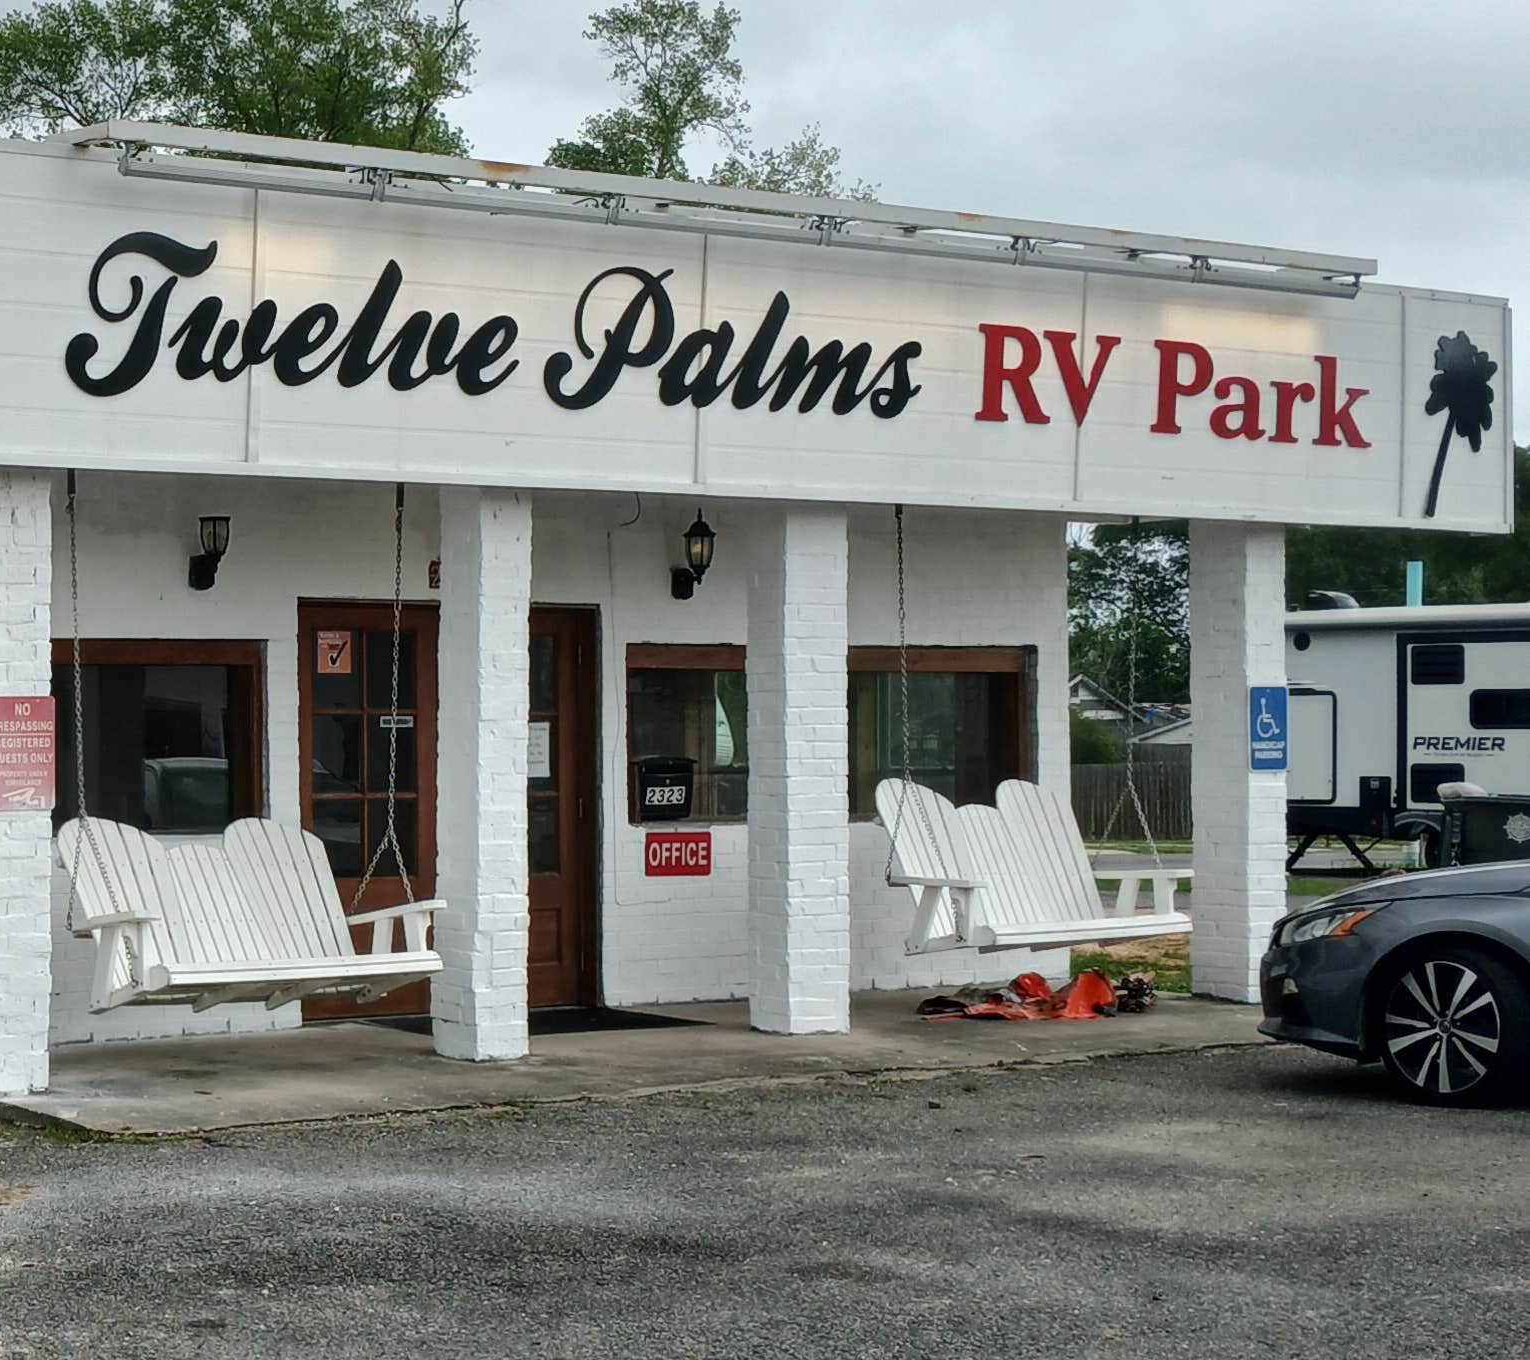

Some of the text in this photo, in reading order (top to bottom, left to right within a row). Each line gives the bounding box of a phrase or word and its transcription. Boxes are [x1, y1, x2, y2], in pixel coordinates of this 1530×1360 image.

[65, 230, 1372, 449] Twelve Palms RV Park
[14, 703, 31, 717] NO
[1412, 736, 1506, 752] PREMIER
[30, 753, 54, 764] ONLY
[647, 788, 684, 803] 2323
[648, 842, 707, 866] OFFICE
